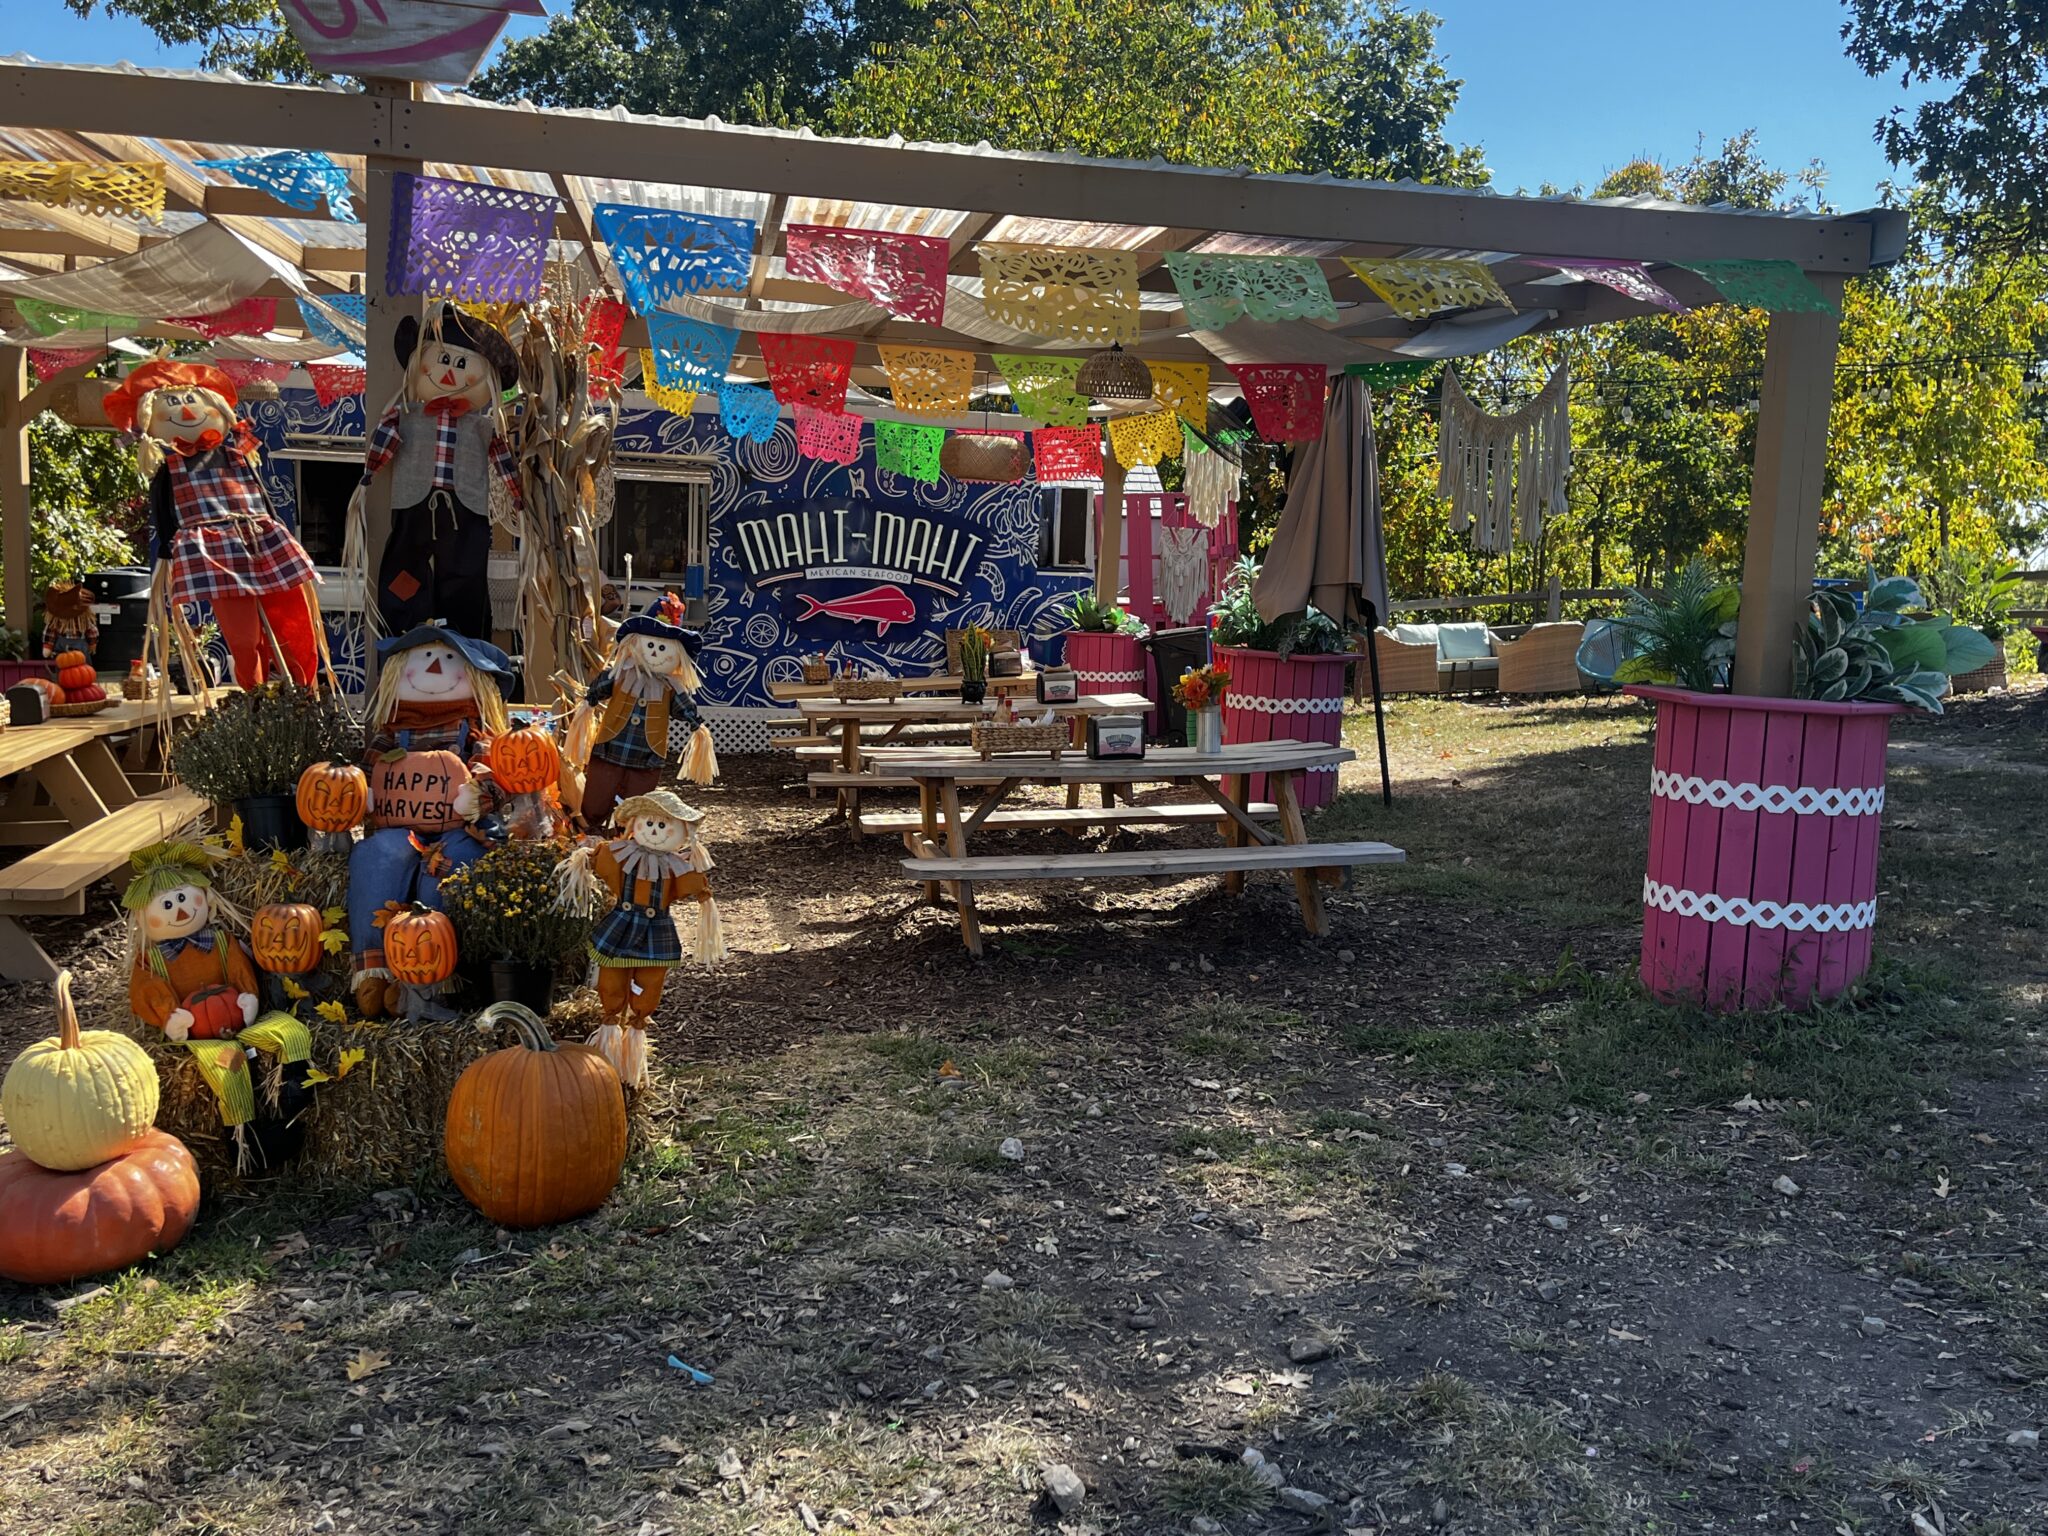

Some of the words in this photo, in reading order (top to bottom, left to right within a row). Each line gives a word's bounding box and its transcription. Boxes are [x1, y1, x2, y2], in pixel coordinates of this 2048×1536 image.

[737, 510, 982, 585] MAHI-MAHI
[810, 568, 857, 577] MEXICAN
[860, 569, 909, 582] SEAFOOD
[384, 772, 451, 794] HAPPY
[374, 799, 454, 820] HARVEST
